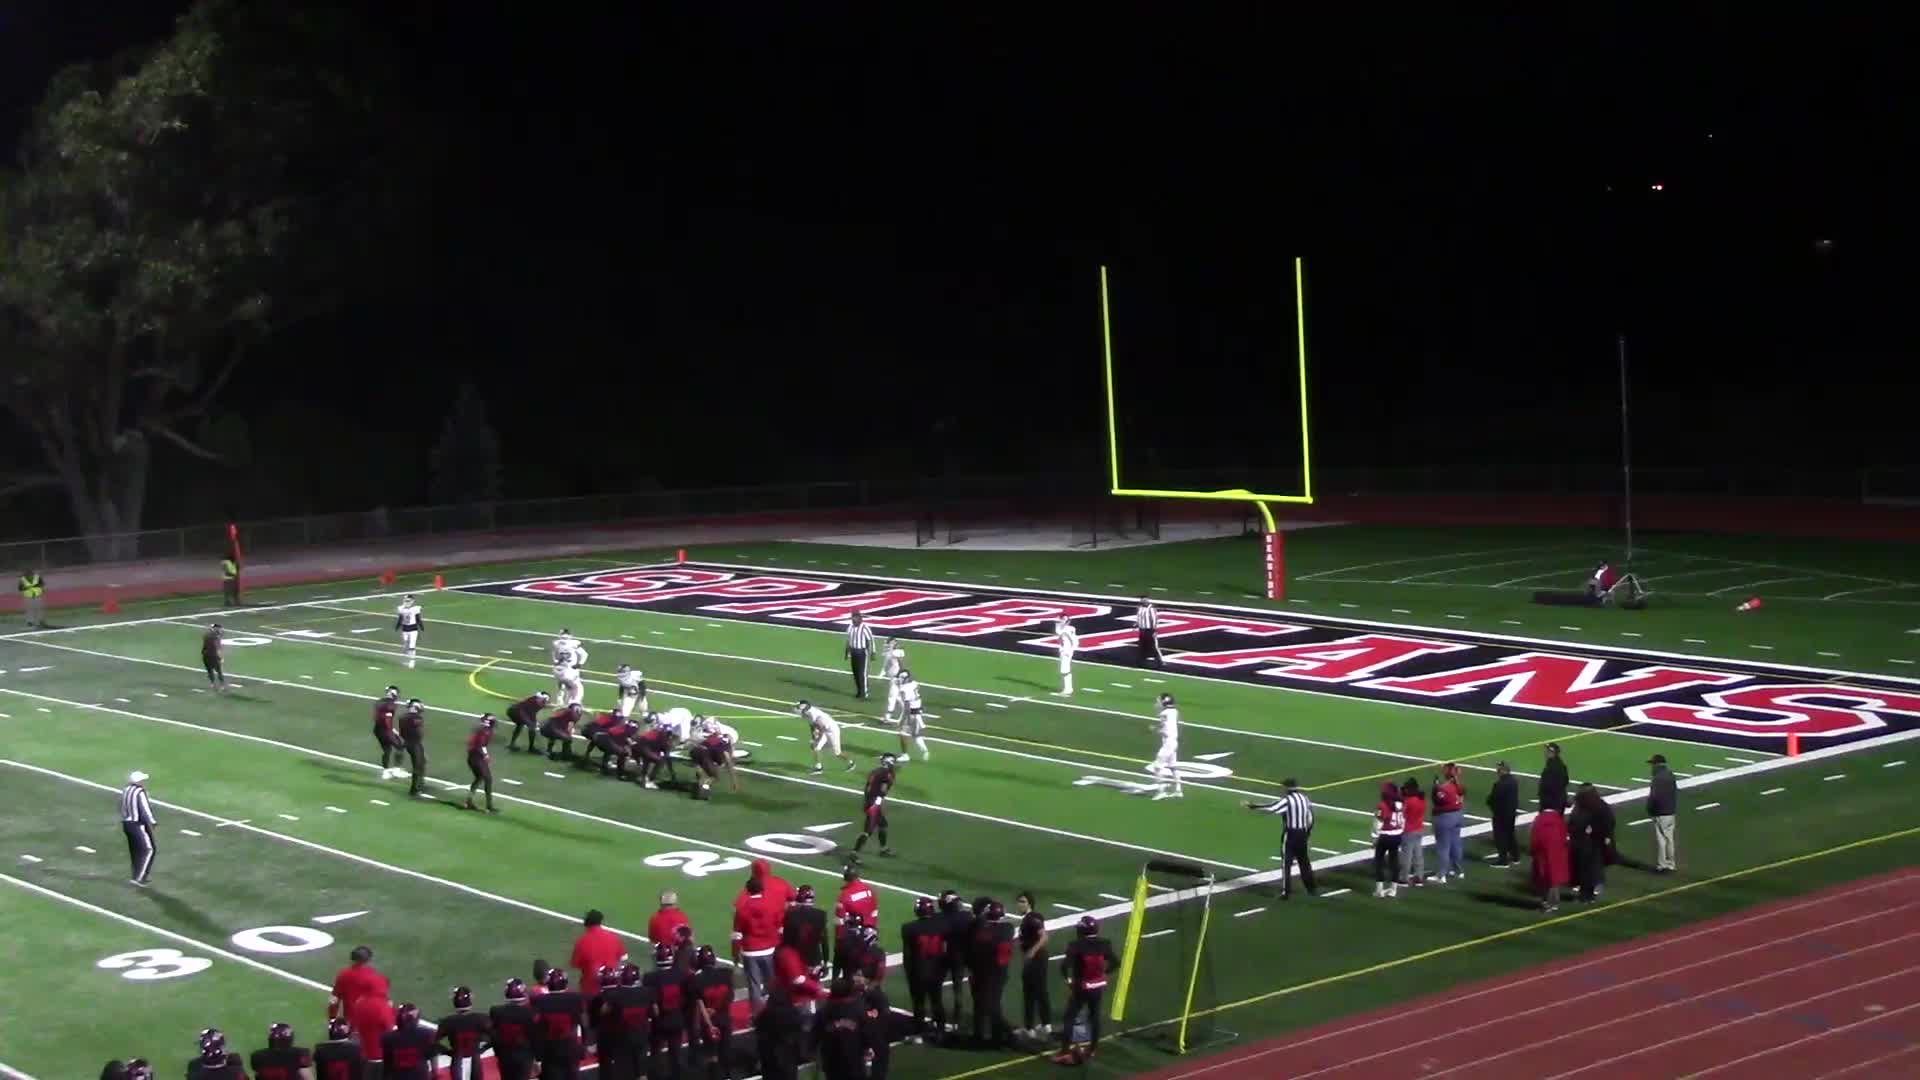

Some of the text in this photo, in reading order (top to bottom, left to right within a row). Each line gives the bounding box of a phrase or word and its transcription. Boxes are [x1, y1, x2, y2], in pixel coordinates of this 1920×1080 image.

[512, 566, 1920, 738] SPARTANS
[643, 833, 838, 877] 20
[96, 925, 336, 981] 30
